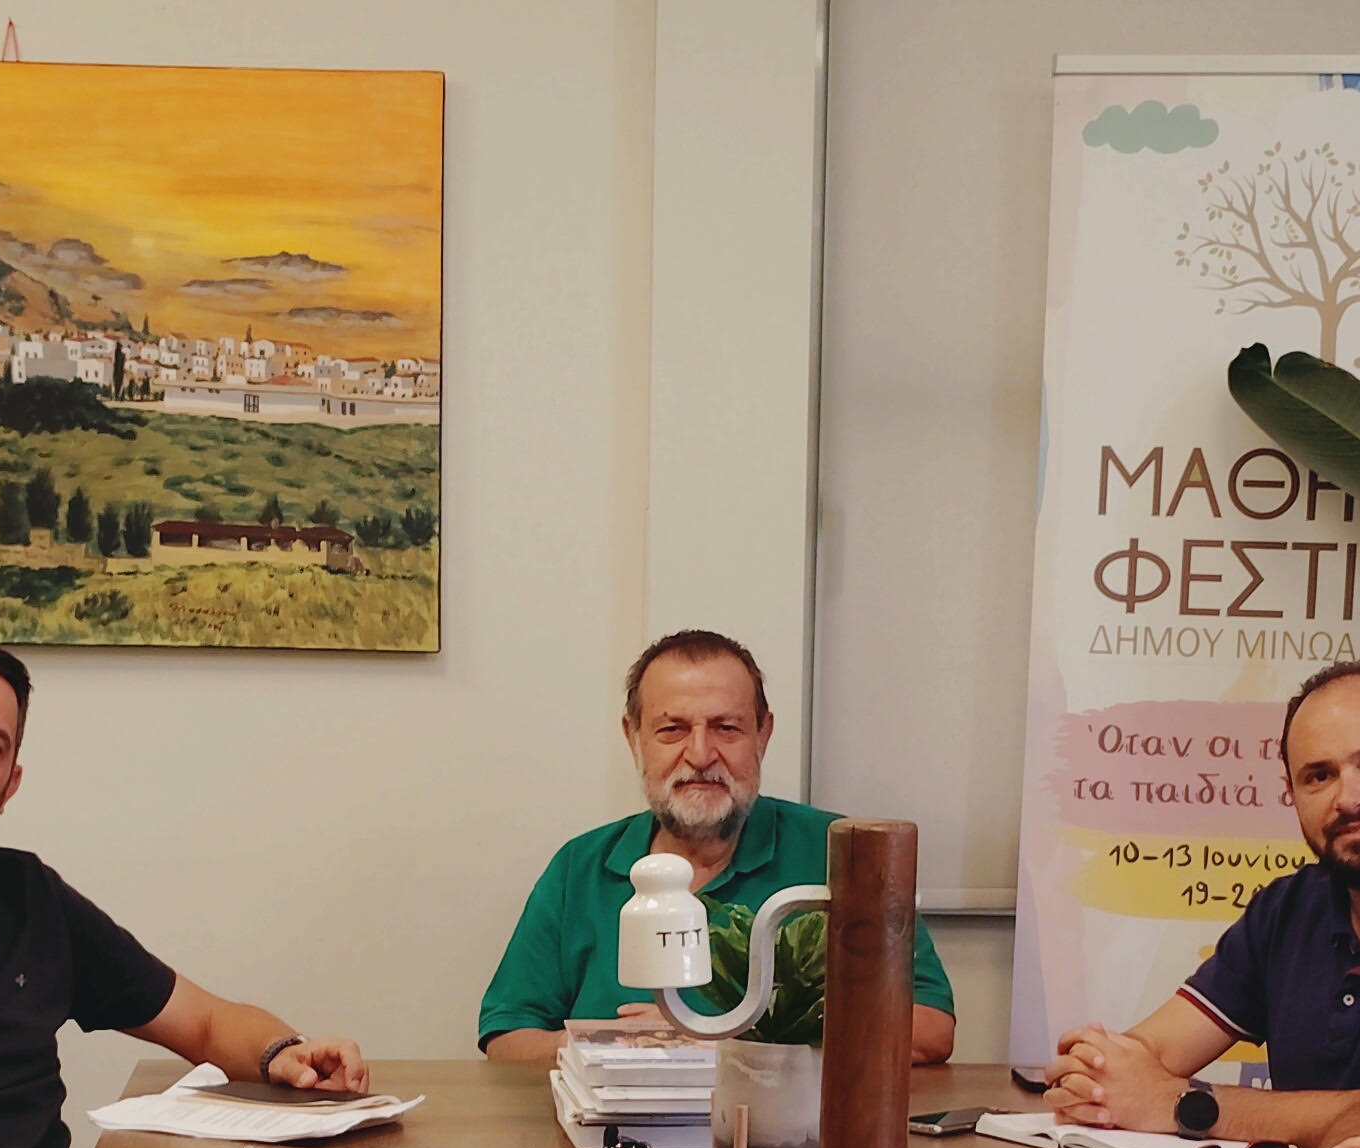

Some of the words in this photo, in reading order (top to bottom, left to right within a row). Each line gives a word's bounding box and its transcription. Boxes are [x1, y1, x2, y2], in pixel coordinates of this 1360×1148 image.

[1089, 624, 1223, 658] ΔΗΜΟΥ
[1236, 628, 1357, 662] ΜΙΝΩΑ
[1206, 736, 1244, 760] οι
[1073, 778, 1114, 801] τα
[1130, 772, 1264, 808] παιδιά
[1109, 841, 1192, 869] 10-13
[1202, 845, 1307, 872] Ιουνίου
